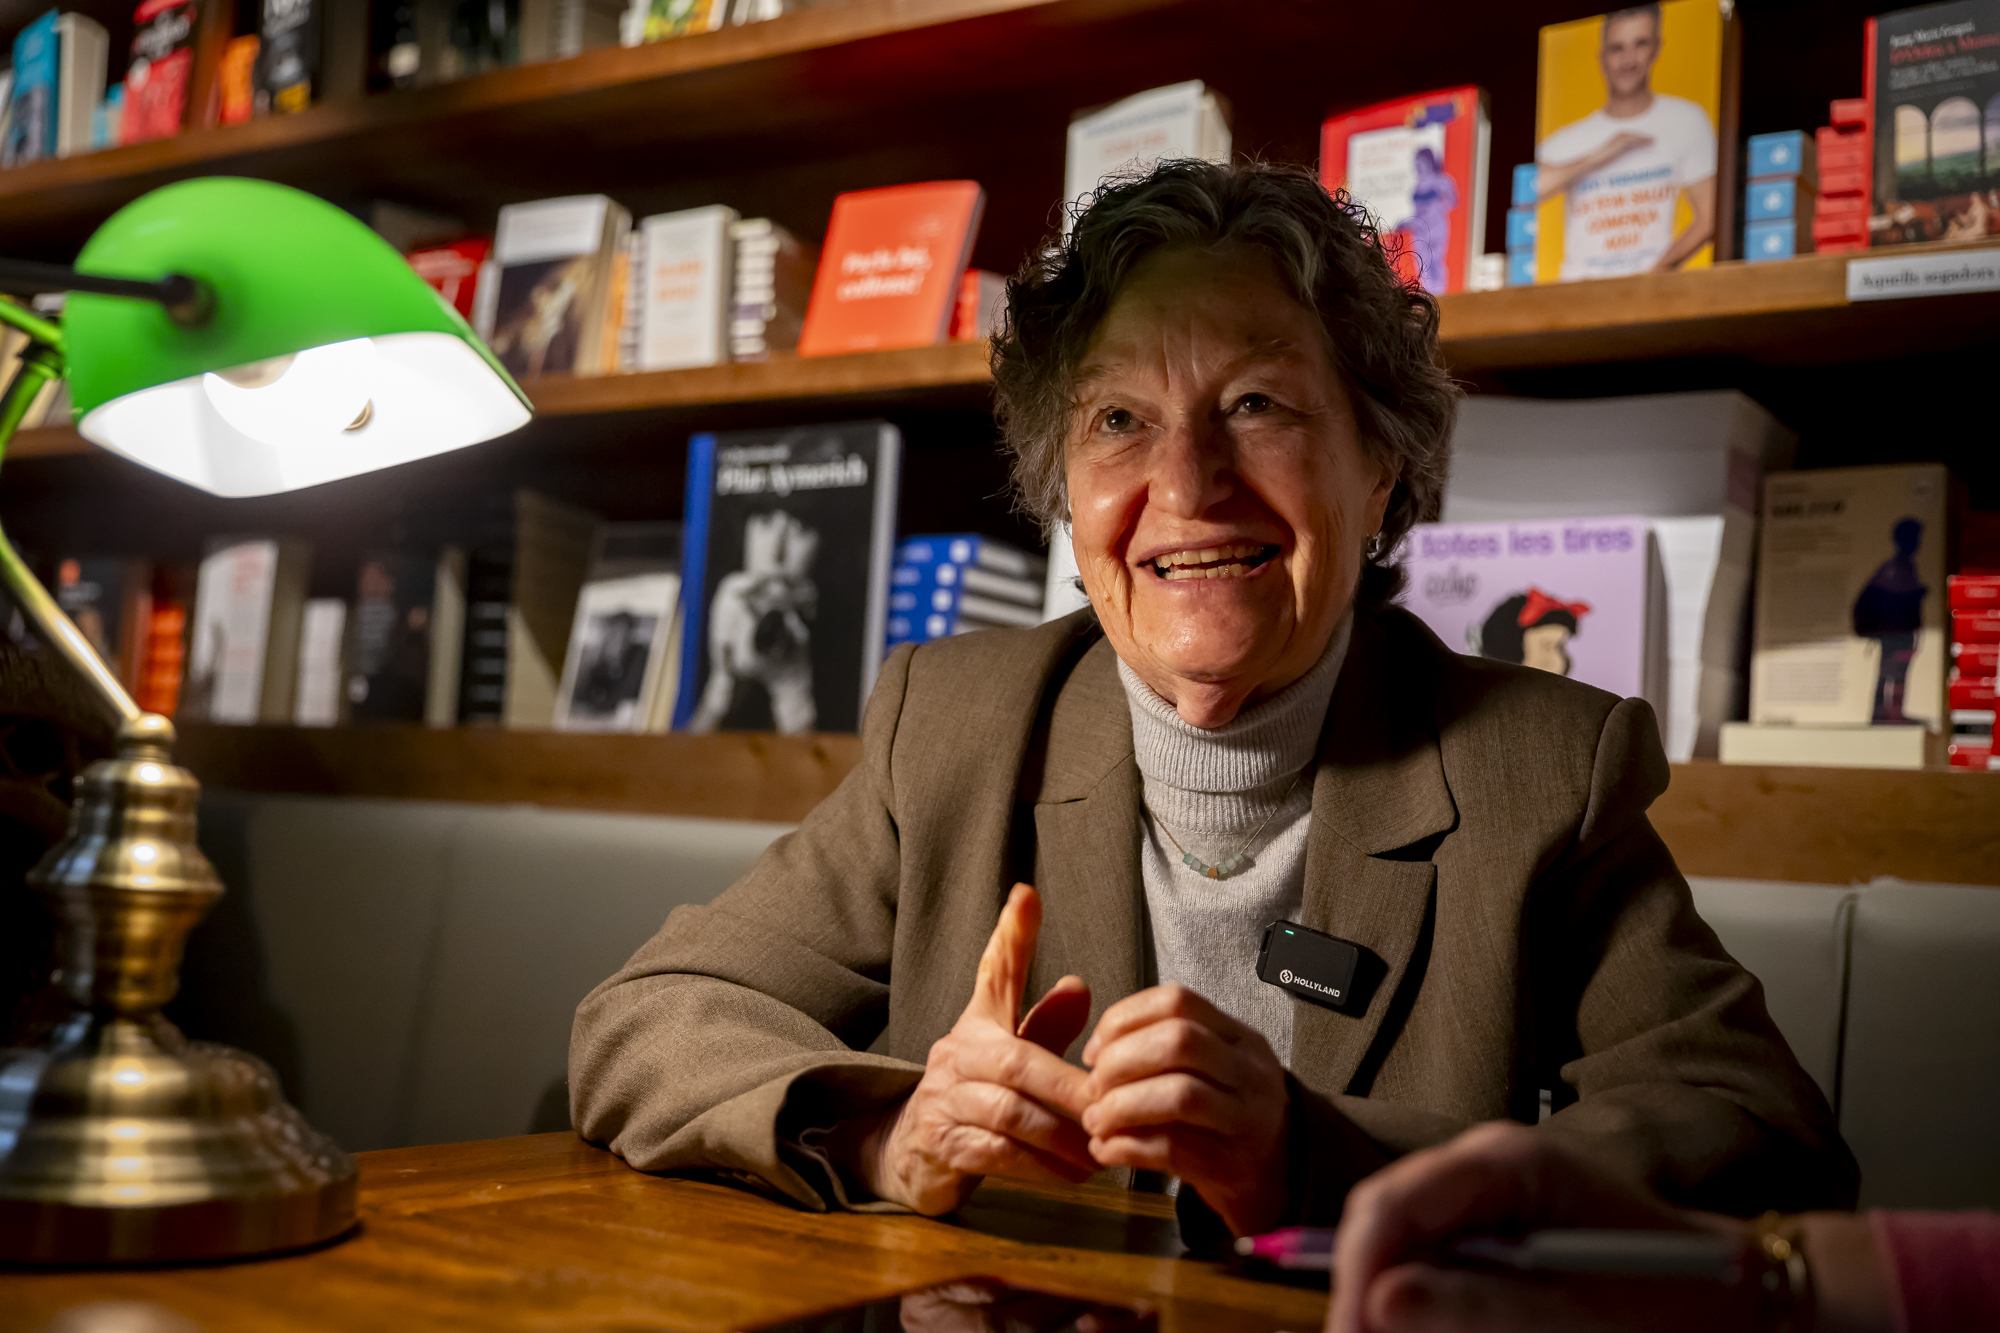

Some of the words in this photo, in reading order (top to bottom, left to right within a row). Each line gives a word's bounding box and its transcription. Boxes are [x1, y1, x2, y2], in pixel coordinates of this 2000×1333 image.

[768, 454, 867, 495] Aymerich
[1508, 526, 1554, 555] les
[1562, 522, 1634, 553] tires
[1293, 975, 1341, 998] HOLLYLAND
